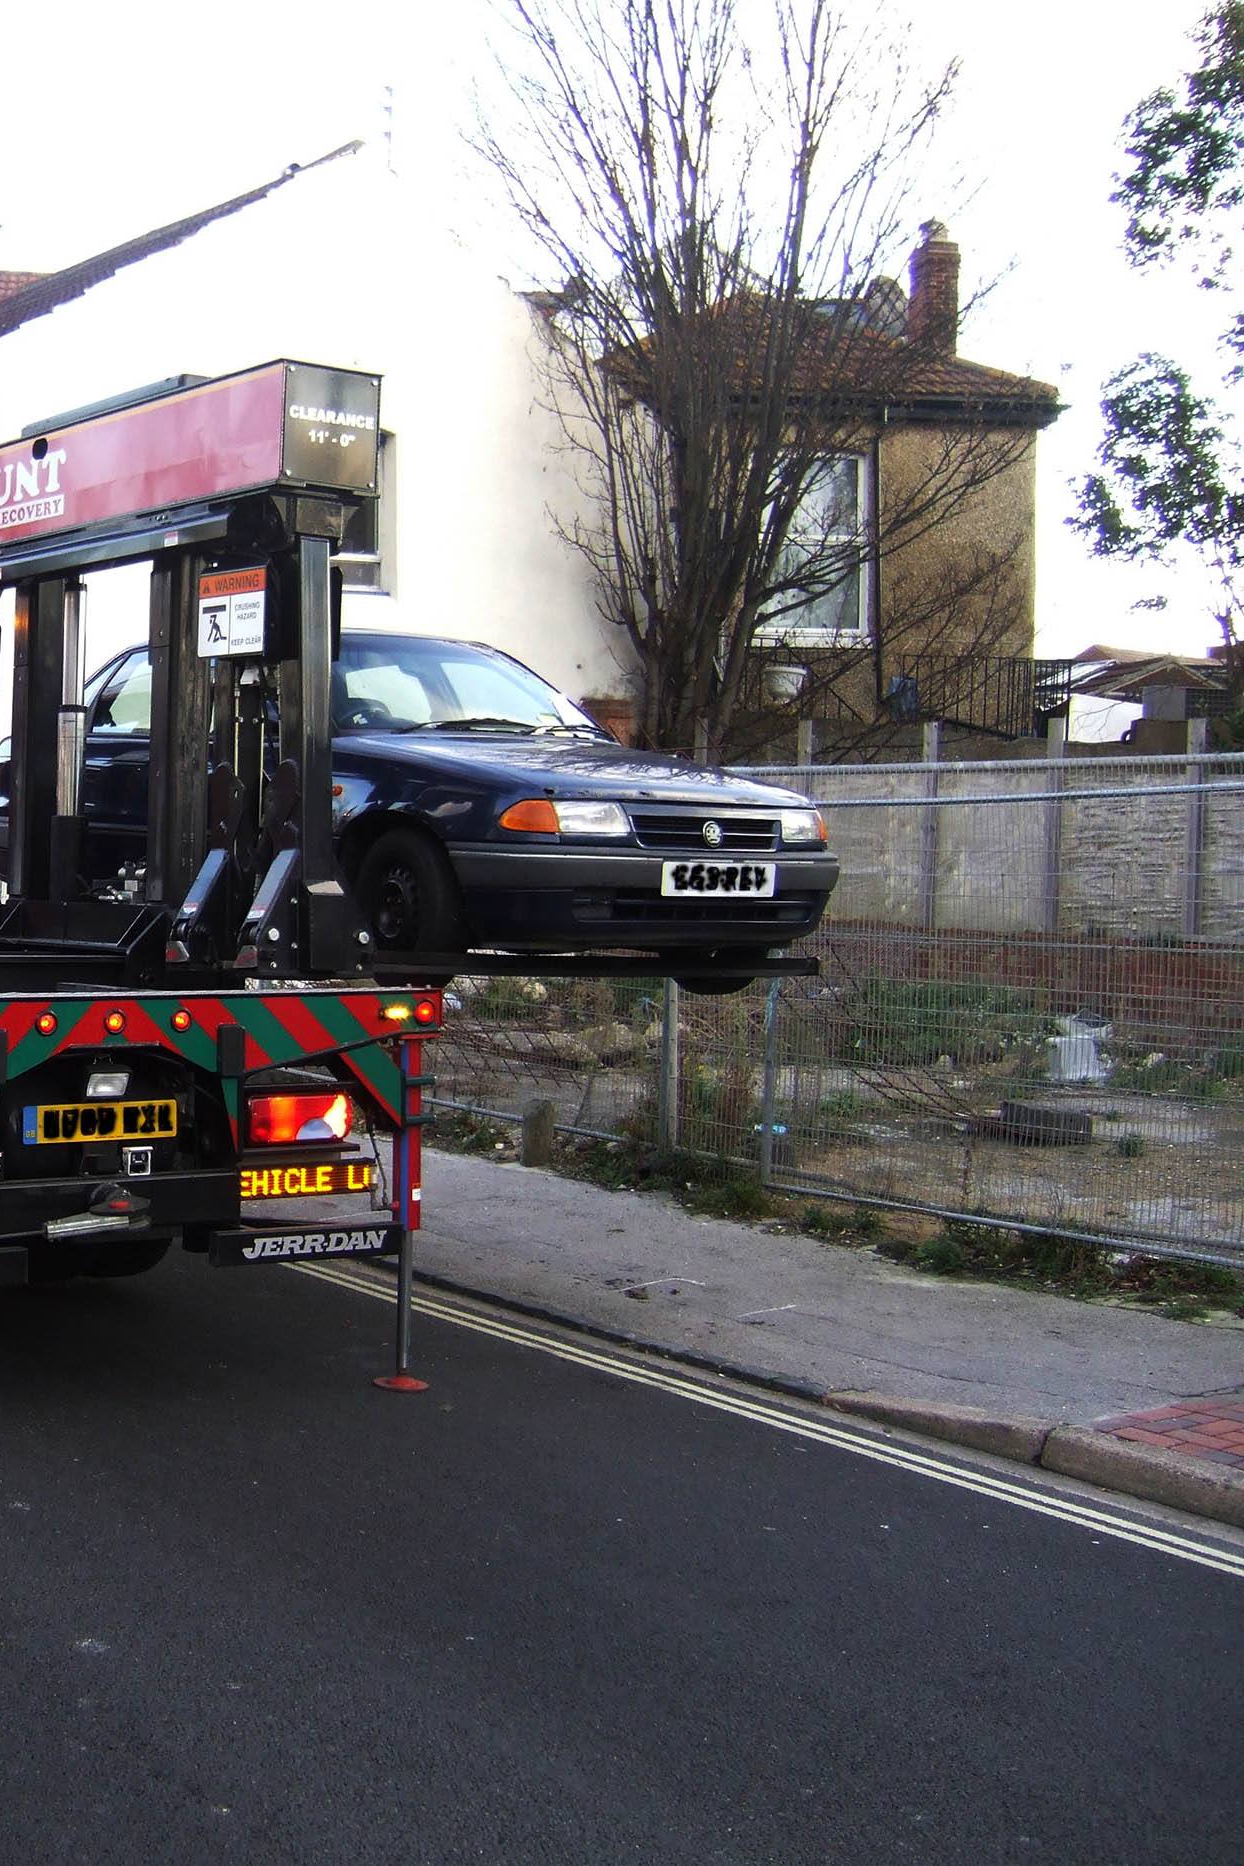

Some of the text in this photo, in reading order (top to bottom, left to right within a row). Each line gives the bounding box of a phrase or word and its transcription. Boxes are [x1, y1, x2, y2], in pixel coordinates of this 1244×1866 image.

[289, 404, 375, 430] CLEARANCE
[215, 574, 259, 591] WARNING
[235, 602, 260, 611] CRUSHING
[237, 612, 257, 620] HAZARD
